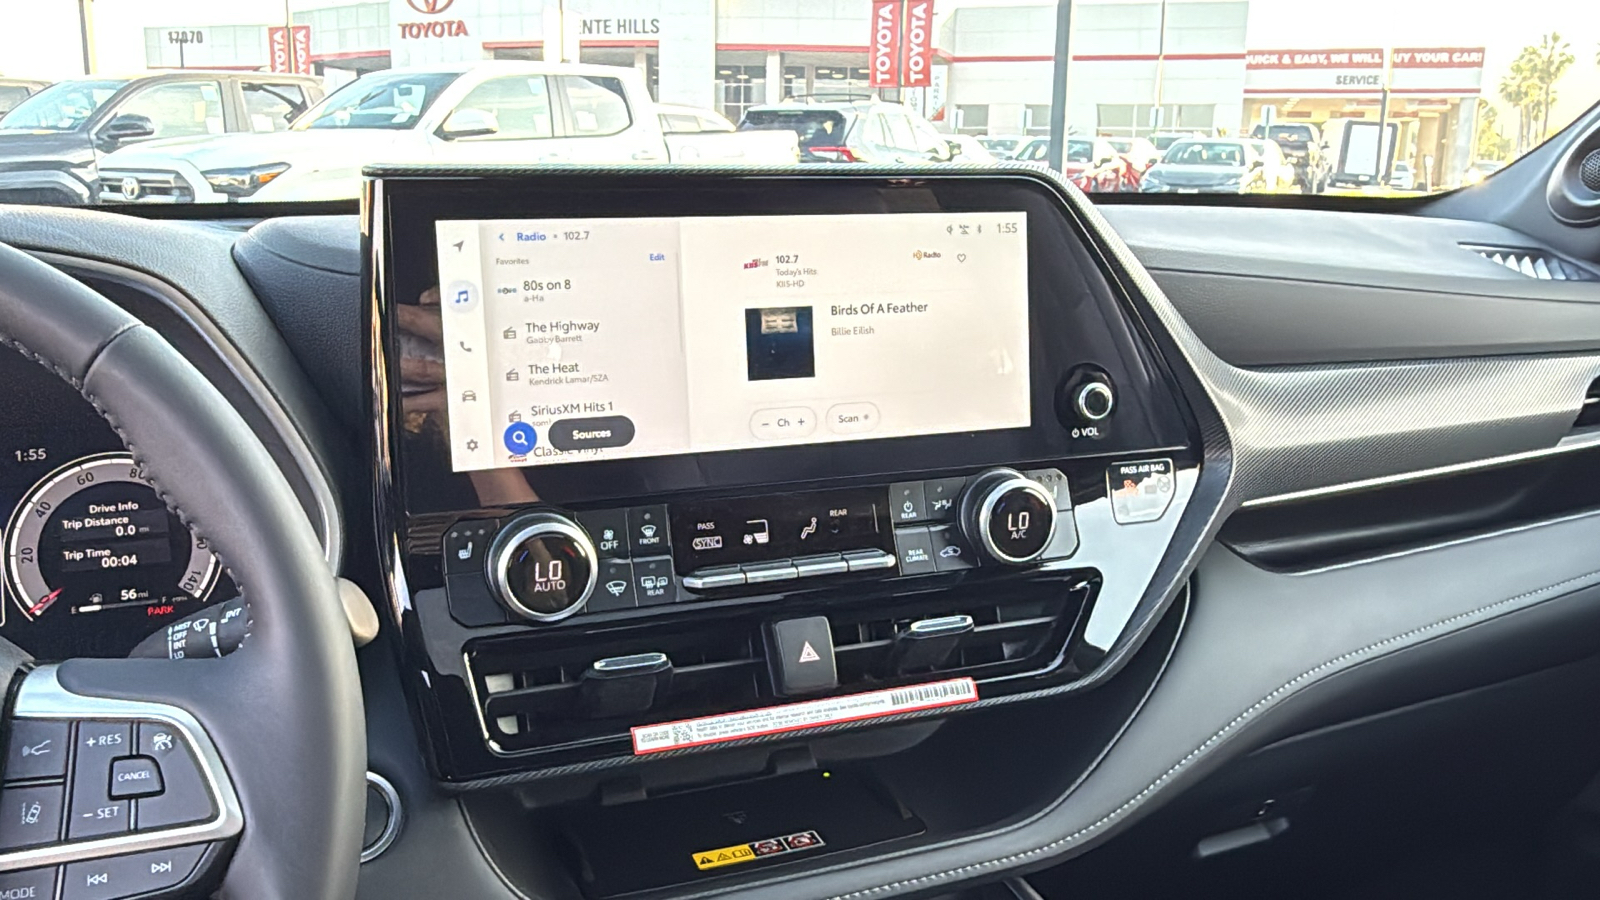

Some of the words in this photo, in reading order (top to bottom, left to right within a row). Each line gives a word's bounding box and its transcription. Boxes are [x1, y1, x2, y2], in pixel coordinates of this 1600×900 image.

[398, 20, 469, 39] TOYOTA
[579, 19, 612, 35] NTE
[617, 18, 660, 35] HILLS
[876, 3, 894, 83] TOYOTA
[909, 3, 927, 83] TOYOTA
[1329, 53, 1350, 64] WE
[1351, 52, 1383, 63] WILL
[1414, 52, 1450, 63] YOUR
[1452, 51, 1483, 63] CAR!
[1335, 74, 1380, 86] SERVICE
[996, 222, 1019, 234] 1:55
[516, 231, 548, 242] Radio
[563, 230, 590, 241] 102.7
[649, 252, 666, 262] Edit
[775, 254, 799, 264] 102.7
[923, 251, 942, 259] Radio
[495, 257, 530, 266] Favorites
[775, 268, 802, 278] Today's
[802, 267, 817, 276] Hits
[522, 279, 544, 292] 80s
[546, 281, 561, 290] on
[563, 278, 572, 290] 8
[523, 294, 545, 303] a-Ha
[830, 305, 858, 317] Birds
[860, 303, 876, 315] Of
[876, 304, 886, 314] A
[886, 302, 929, 315] Feather
[525, 321, 548, 333] The
[549, 320, 601, 335] Highway
[830, 326, 852, 336] Billie
[852, 325, 875, 335] Eilish
[526, 335, 554, 345] Gabby
[554, 334, 582, 343] Barrett
[528, 362, 550, 374] The
[552, 361, 580, 373] Heat
[528, 376, 564, 386] Kendrick
[564, 373, 609, 384] Lamar/SZA
[530, 402, 581, 416] SiriusXM
[583, 401, 607, 413] Hits
[607, 400, 613, 412] 1
[777, 417, 790, 427] Ch
[838, 413, 859, 424] Scan
[572, 428, 612, 440] Sources
[1081, 427, 1099, 437] VOL
[15, 448, 47, 462] 1:55
[1120, 465, 1138, 474] PASS
[1138, 465, 1150, 473] AIR
[1150, 463, 1165, 472] BAG
[76, 471, 95, 485] 60
[35, 501, 52, 519] 40
[89, 504, 117, 515] Drive
[118, 502, 139, 512] Info
[829, 509, 848, 517] REAR
[62, 519, 83, 531] Trip
[84, 516, 130, 528] Distance
[697, 522, 715, 530] PASS
[1007, 511, 1030, 531] LO
[115, 525, 136, 536] 0.0
[1011, 530, 1027, 539] A/C
[600, 540, 619, 550] OFF
[639, 536, 660, 545] FRONT
[696, 537, 720, 547] SYNC
[20, 547, 34, 564] 20
[63, 551, 83, 563] Trip
[85, 548, 111, 559] Time
[905, 554, 929, 563] CLIMATE
[101, 556, 138, 568] 00:04
[183, 570, 202, 591] 140
[534, 580, 566, 593] AUTO
[120, 589, 138, 601] 56
[138, 590, 149, 599] mi
[70, 606, 77, 615] E
[147, 606, 174, 616] PARK
[173, 631, 188, 641] OFF
[173, 640, 186, 650] INT
[173, 652, 185, 660] LO
[98, 733, 122, 746] RES
[117, 772, 151, 782] CANCEL
[96, 806, 119, 819] SET
[0, 886, 36, 900] MODE
